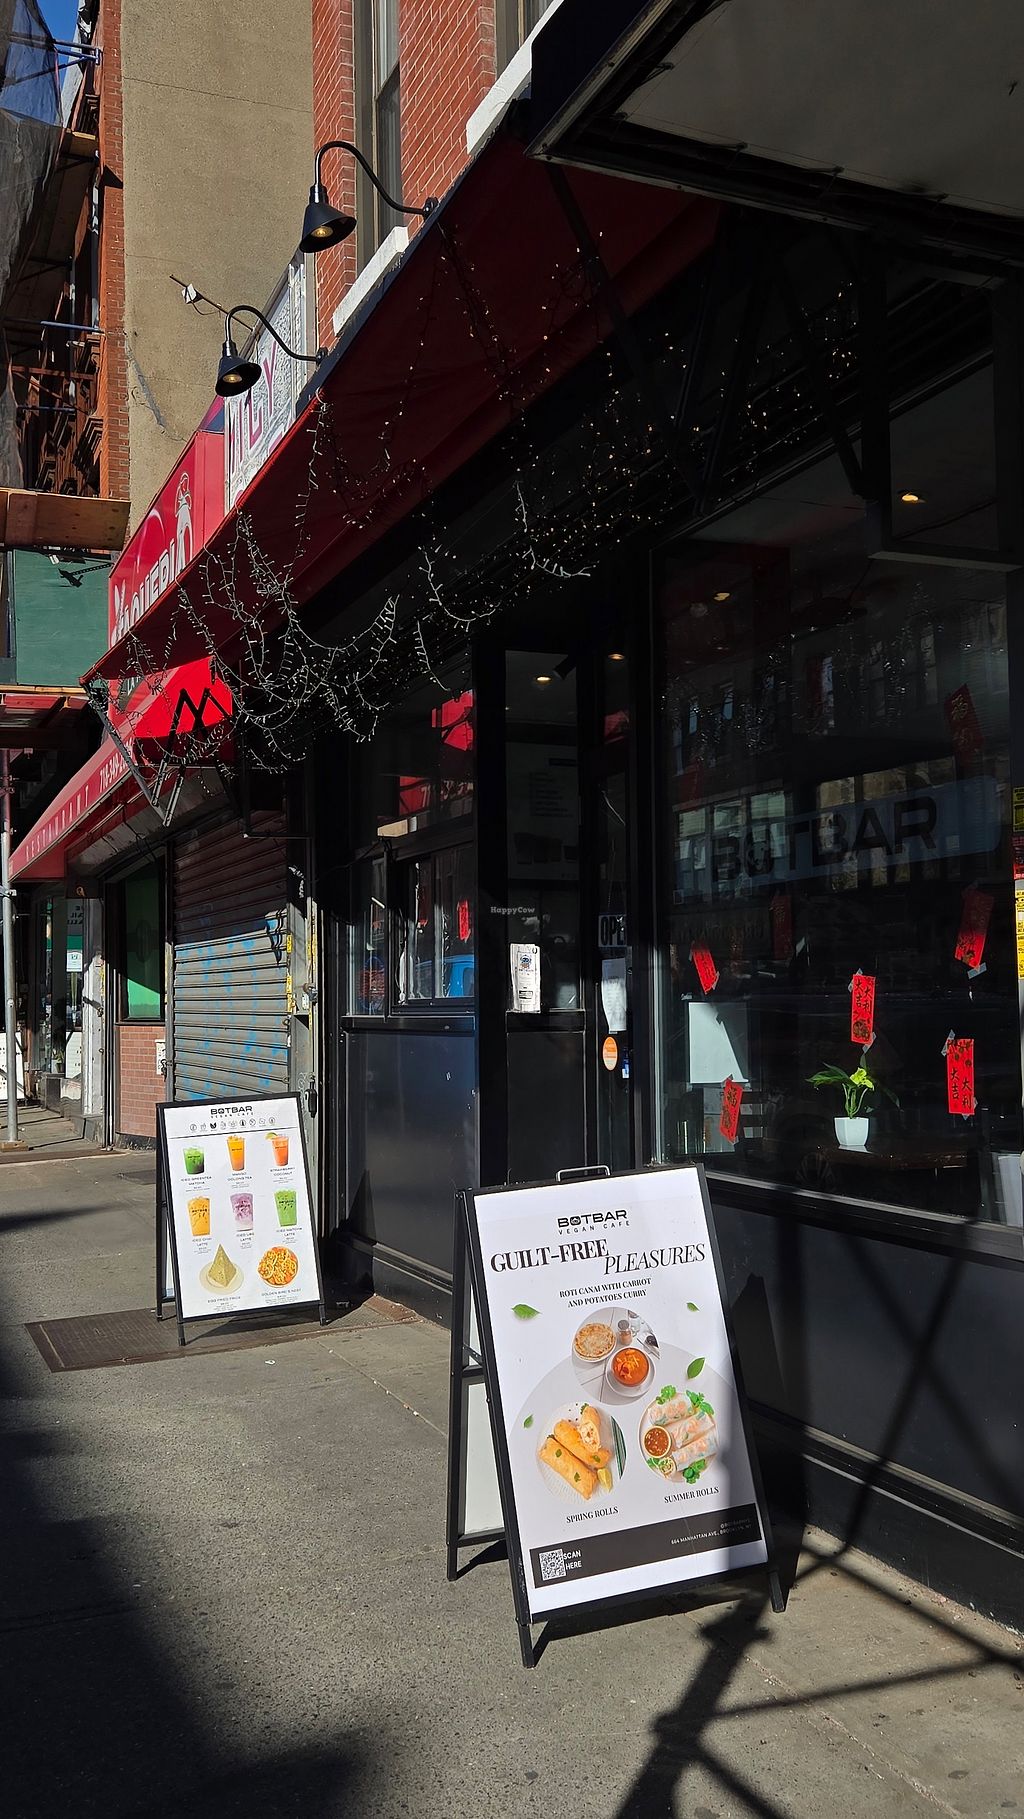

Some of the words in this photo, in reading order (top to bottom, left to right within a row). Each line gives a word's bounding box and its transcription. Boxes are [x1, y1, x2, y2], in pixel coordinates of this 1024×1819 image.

[712, 795, 938, 883] BOTBAR
[211, 1106, 252, 1115] BOTBAR
[557, 1209, 627, 1228] BOTBAR
[558, 1225, 595, 1235] VEGAN
[603, 1220, 630, 1229] CAFE
[490, 1239, 609, 1273] GUILT-FREE
[604, 1243, 705, 1275] PLEASURES
[559, 1289, 577, 1298] ROTI
[578, 1286, 600, 1296] CANAI
[601, 1282, 621, 1292] WITH
[622, 1277, 652, 1288] CARROT
[568, 1299, 584, 1308] AND
[584, 1293, 623, 1305] POTATOES
[623, 1289, 647, 1299] CURRY
[664, 1490, 696, 1504] SUMMER
[695, 1486, 720, 1498] ROLLS
[566, 1510, 594, 1524] SPRING
[594, 1506, 619, 1519] ROLLS
[562, 1550, 582, 1560] SCAN
[565, 1560, 582, 1571] HERE
